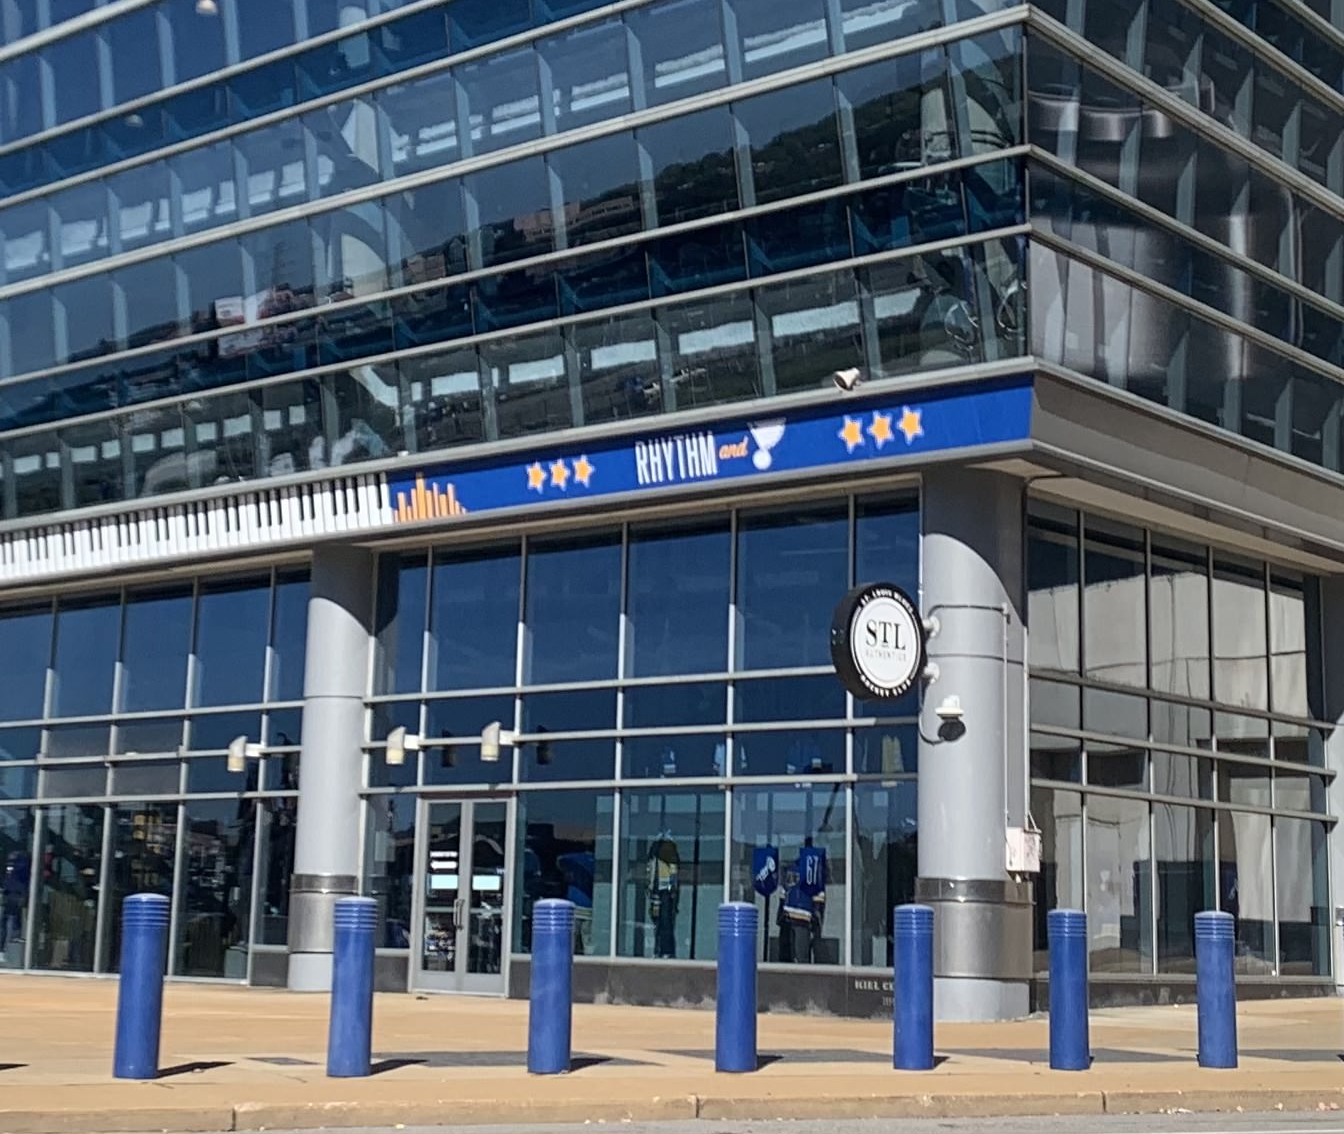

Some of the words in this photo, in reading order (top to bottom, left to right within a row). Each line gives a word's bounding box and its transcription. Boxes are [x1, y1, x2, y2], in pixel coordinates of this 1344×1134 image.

[635, 430, 718, 485] RHYTHM
[719, 435, 749, 460] and
[866, 618, 906, 651] STL
